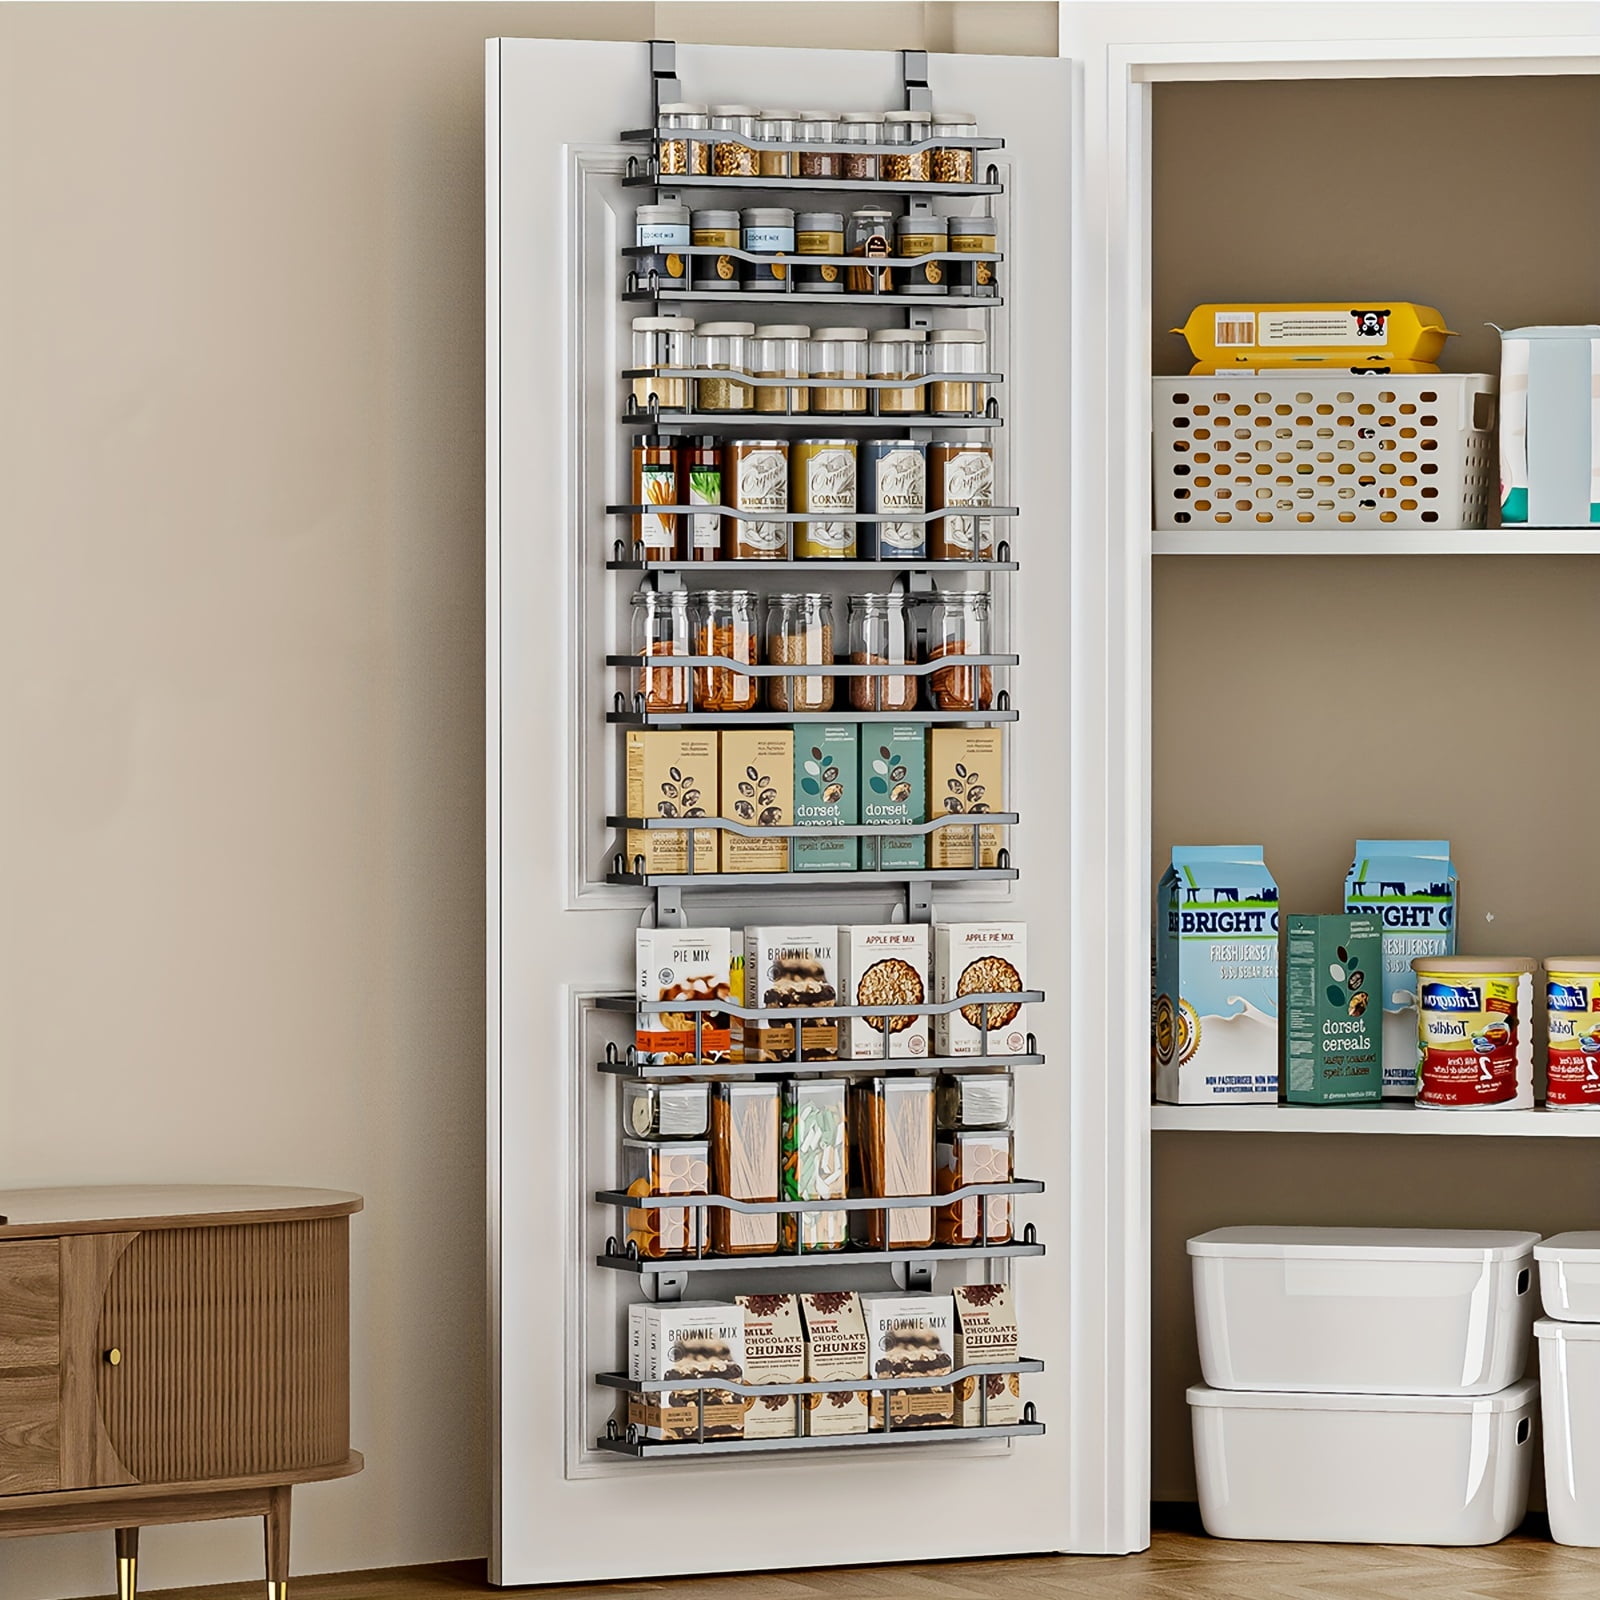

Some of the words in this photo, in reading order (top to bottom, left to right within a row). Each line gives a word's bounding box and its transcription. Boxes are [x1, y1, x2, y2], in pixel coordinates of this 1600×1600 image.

[797, 804, 840, 817] dorset
[865, 803, 908, 816] dorset
[1181, 911, 1266, 933] BRIGHT
[866, 935, 887, 944] APPLE
[889, 935, 899, 944] PIE
[965, 933, 987, 942] APPLE
[988, 933, 1000, 942] PIE
[1240, 944, 1272, 962] JERSEY
[1406, 939, 1440, 955] JERSEY
[673, 950, 688, 962] PIE
[692, 949, 710, 962] MIX
[768, 947, 809, 961] BROWNIE
[814, 947, 832, 959] MIX
[1322, 1018, 1366, 1035] dorset
[1322, 1035, 1371, 1052] cereals
[879, 1317, 924, 1331] BROWNIE
[928, 1316, 947, 1329] MIX
[963, 1318, 991, 1327] MILK
[668, 1327, 714, 1342] BROWNIE
[719, 1326, 738, 1339] MIX
[744, 1328, 773, 1337] MILK
[811, 1325, 839, 1334] MILK
[965, 1325, 1017, 1335] CHOCOLATE
[745, 1336, 801, 1345] CHOCOLATE
[813, 1333, 866, 1343] CHOCOLATE
[966, 1333, 1018, 1345] CHUNKS
[745, 1344, 802, 1356] CHUNKS
[813, 1341, 866, 1353] CHUNKS
